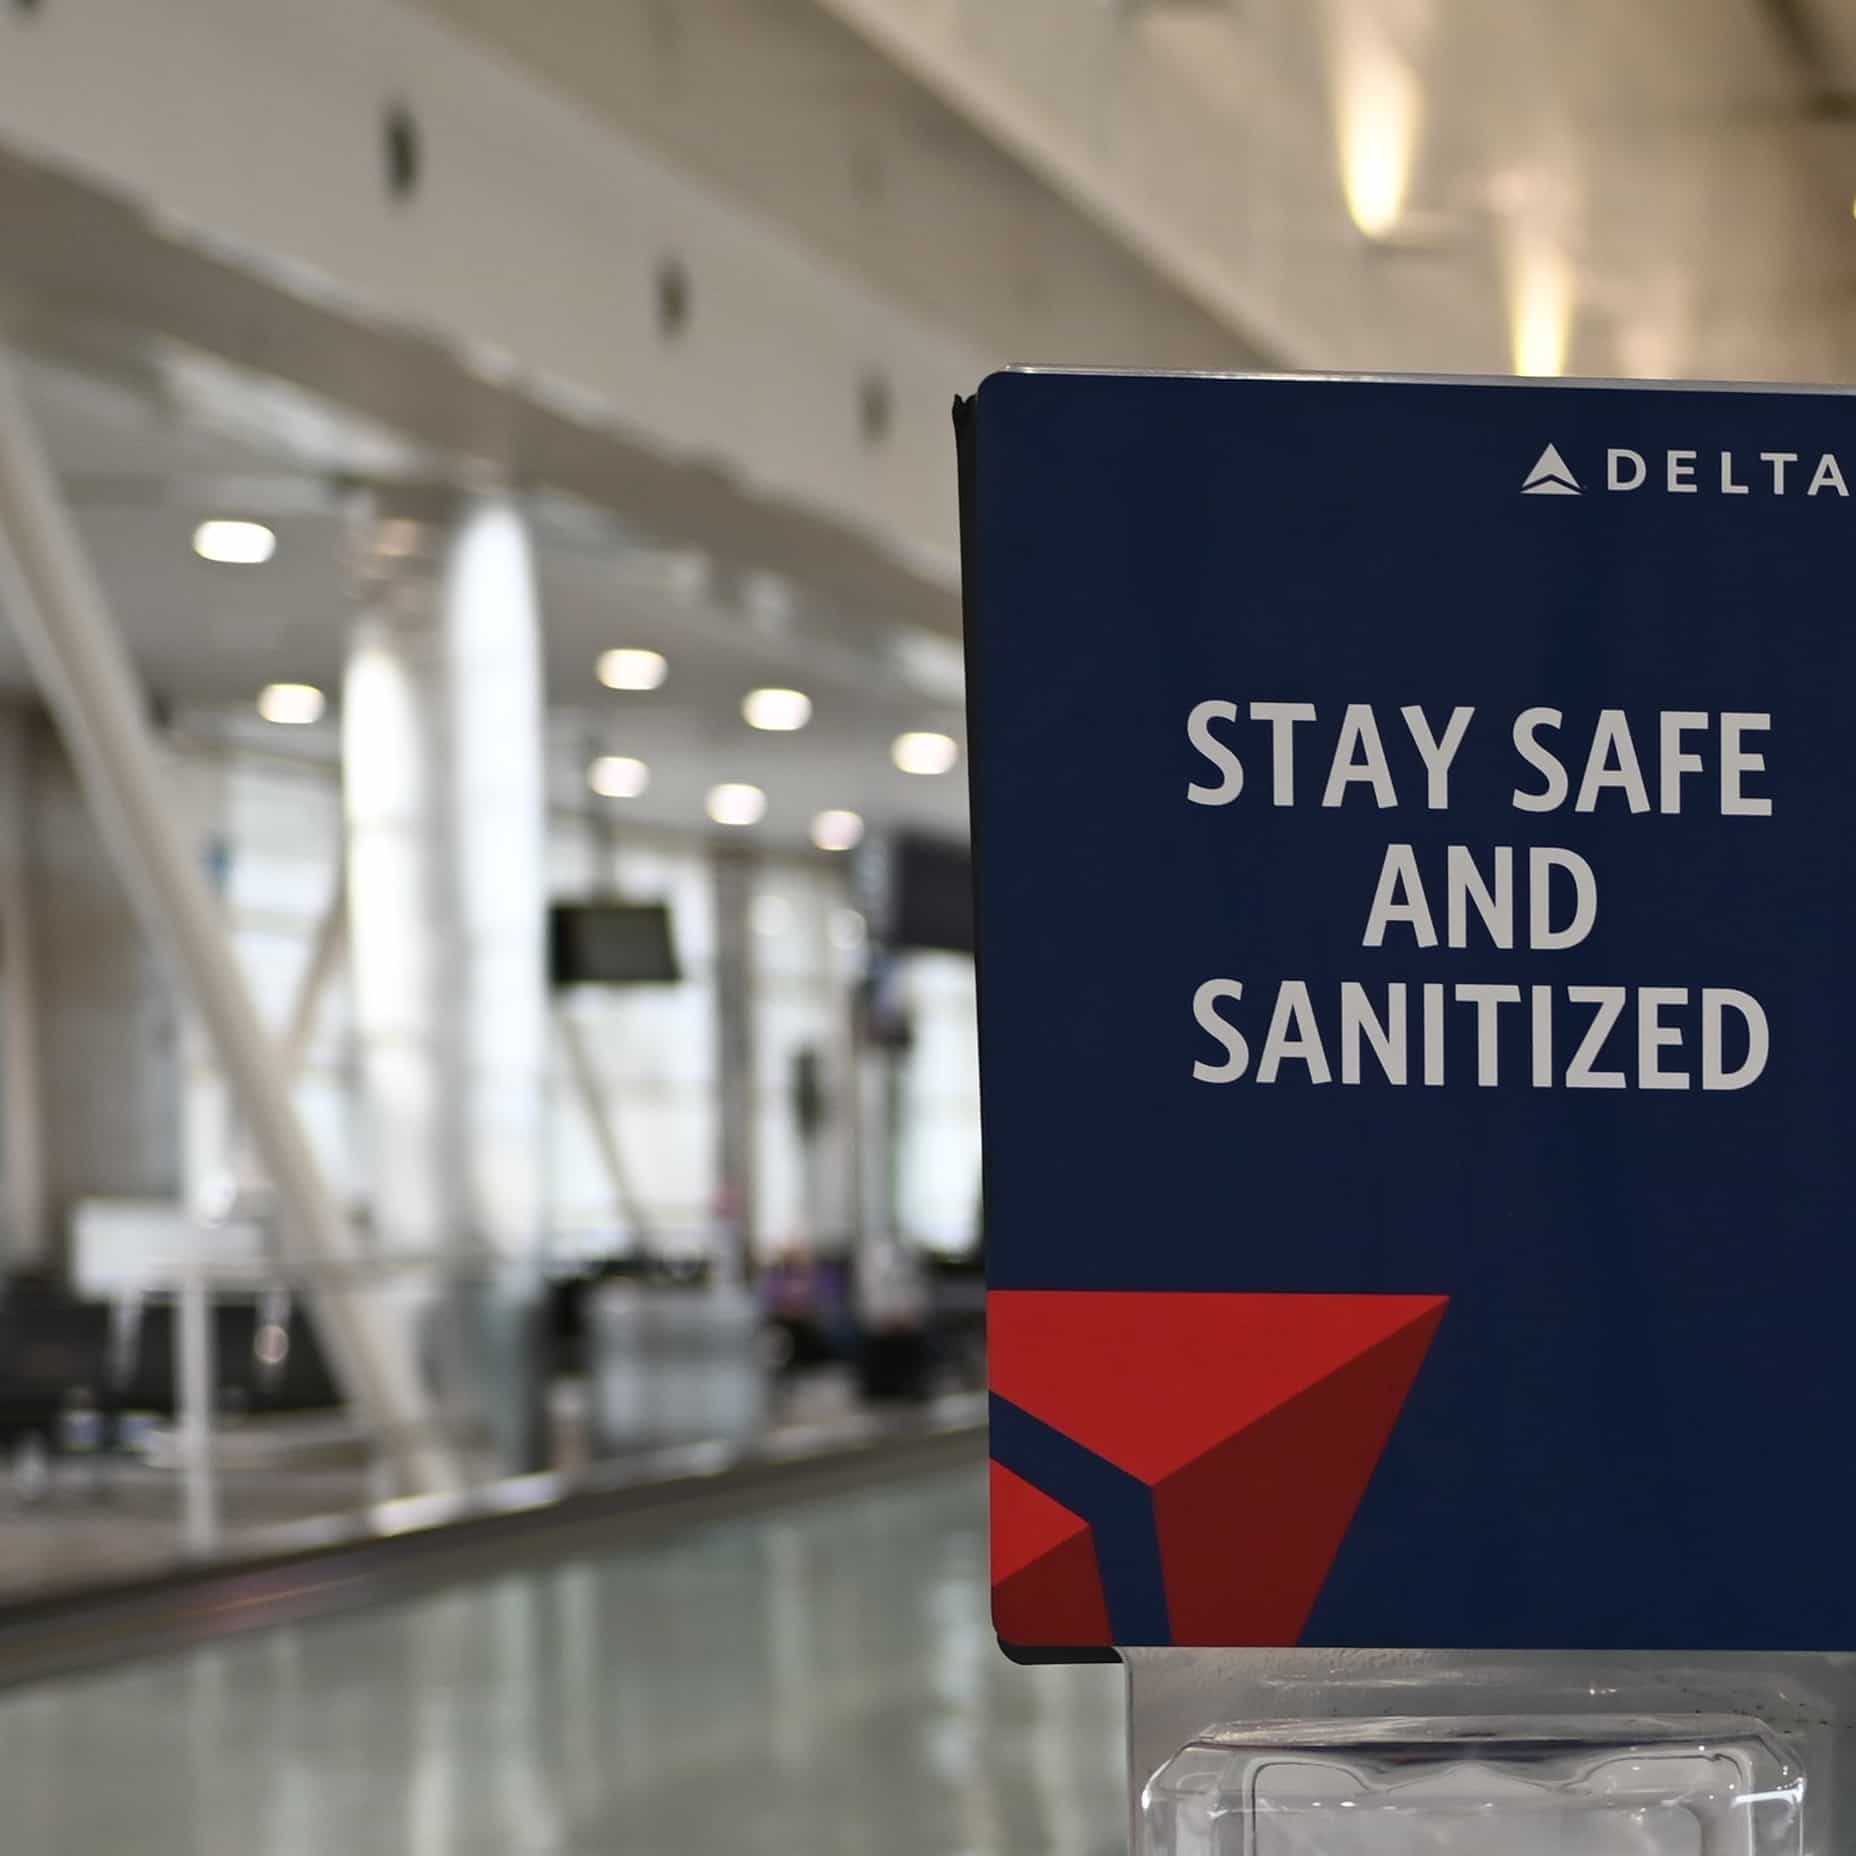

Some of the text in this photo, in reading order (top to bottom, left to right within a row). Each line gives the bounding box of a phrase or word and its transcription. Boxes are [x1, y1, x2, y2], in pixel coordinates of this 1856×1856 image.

[1607, 448, 1850, 497] DELTA
[1186, 699, 1773, 817] STAY SAFE
[1361, 843, 1598, 950] AND
[1192, 978, 1770, 1091] SANITIZED
